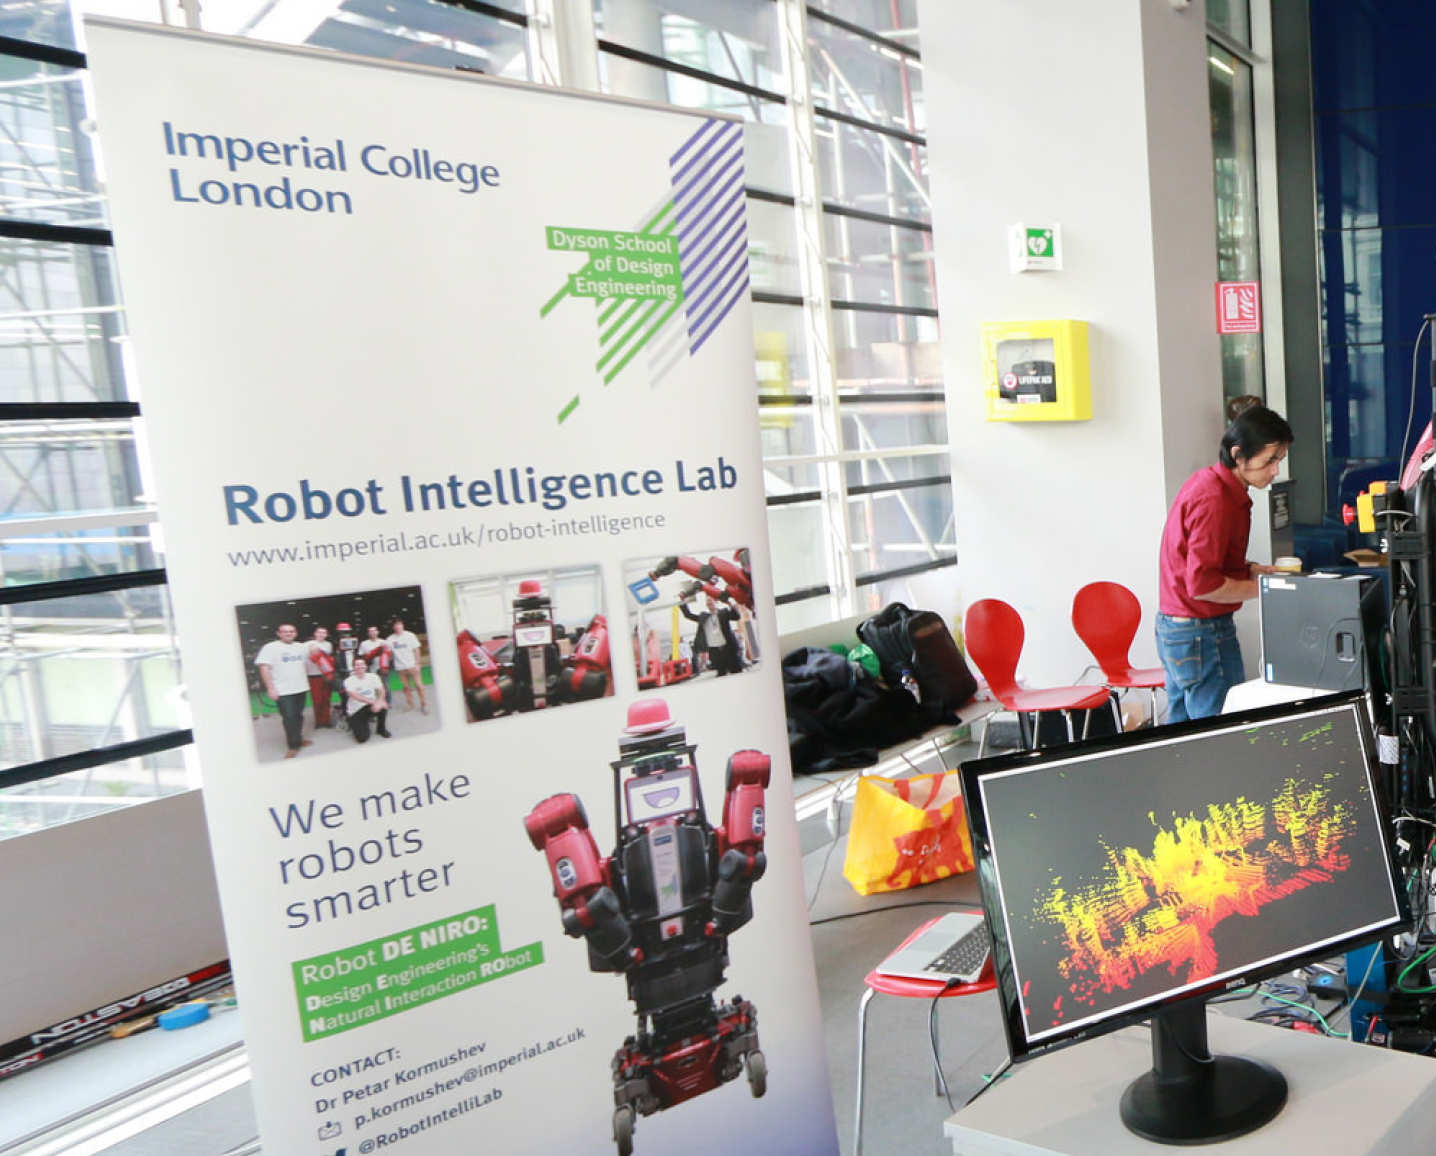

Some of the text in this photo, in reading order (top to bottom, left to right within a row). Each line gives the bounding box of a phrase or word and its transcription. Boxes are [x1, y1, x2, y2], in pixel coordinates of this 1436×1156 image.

[162, 121, 500, 194] Imperial College
[169, 168, 353, 214] London
[551, 229, 672, 253] Dyson School
[593, 255, 674, 278] of Design
[574, 276, 677, 300] Engineering
[223, 456, 737, 526] Robot Intelligence Lab
[227, 513, 666, 567] www.imperial.ac.uk/robot-intelligence
[268, 772, 470, 838] We make
[280, 828, 423, 885] robots
[286, 861, 455, 929] smarter
[301, 914, 488, 985] Robot DE NIRO:
[306, 942, 490, 1012] Design Engineering's
[309, 949, 532, 1034] Natural Interaction RObot
[311, 1047, 401, 1088] CONTACT:
[315, 1041, 487, 1114] Dr Petar Kormushev
[354, 1026, 586, 1130] p.kormushev@imperial.ac.uk
[358, 1088, 503, 1155] @RobotIntelliLab
